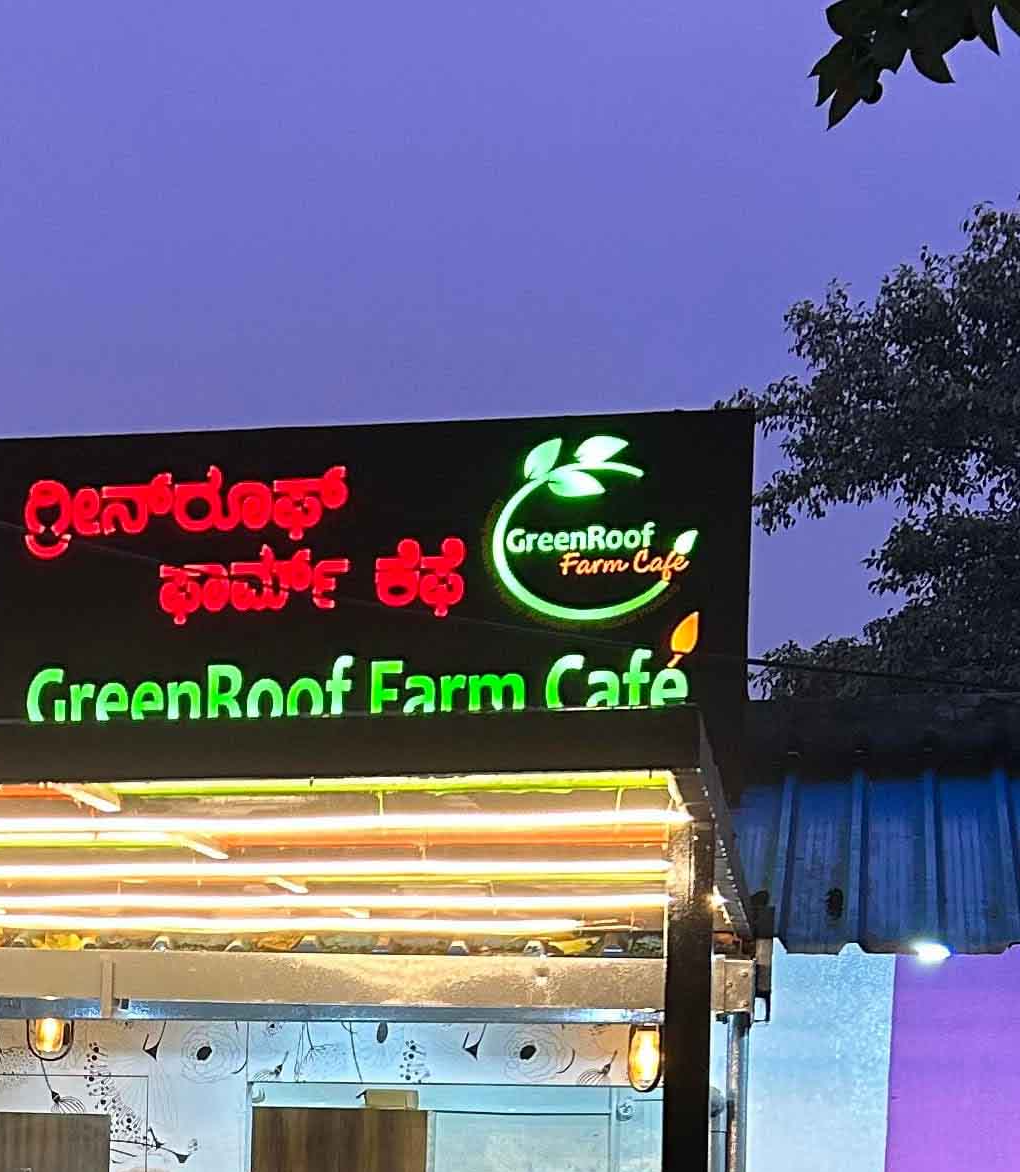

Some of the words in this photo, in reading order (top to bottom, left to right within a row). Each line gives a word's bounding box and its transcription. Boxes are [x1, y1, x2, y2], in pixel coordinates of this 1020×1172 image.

[505, 521, 656, 553] GreenRoof
[559, 551, 629, 576] Farm
[26, 655, 354, 722] GreenRoof
[370, 660, 525, 714] Farm
